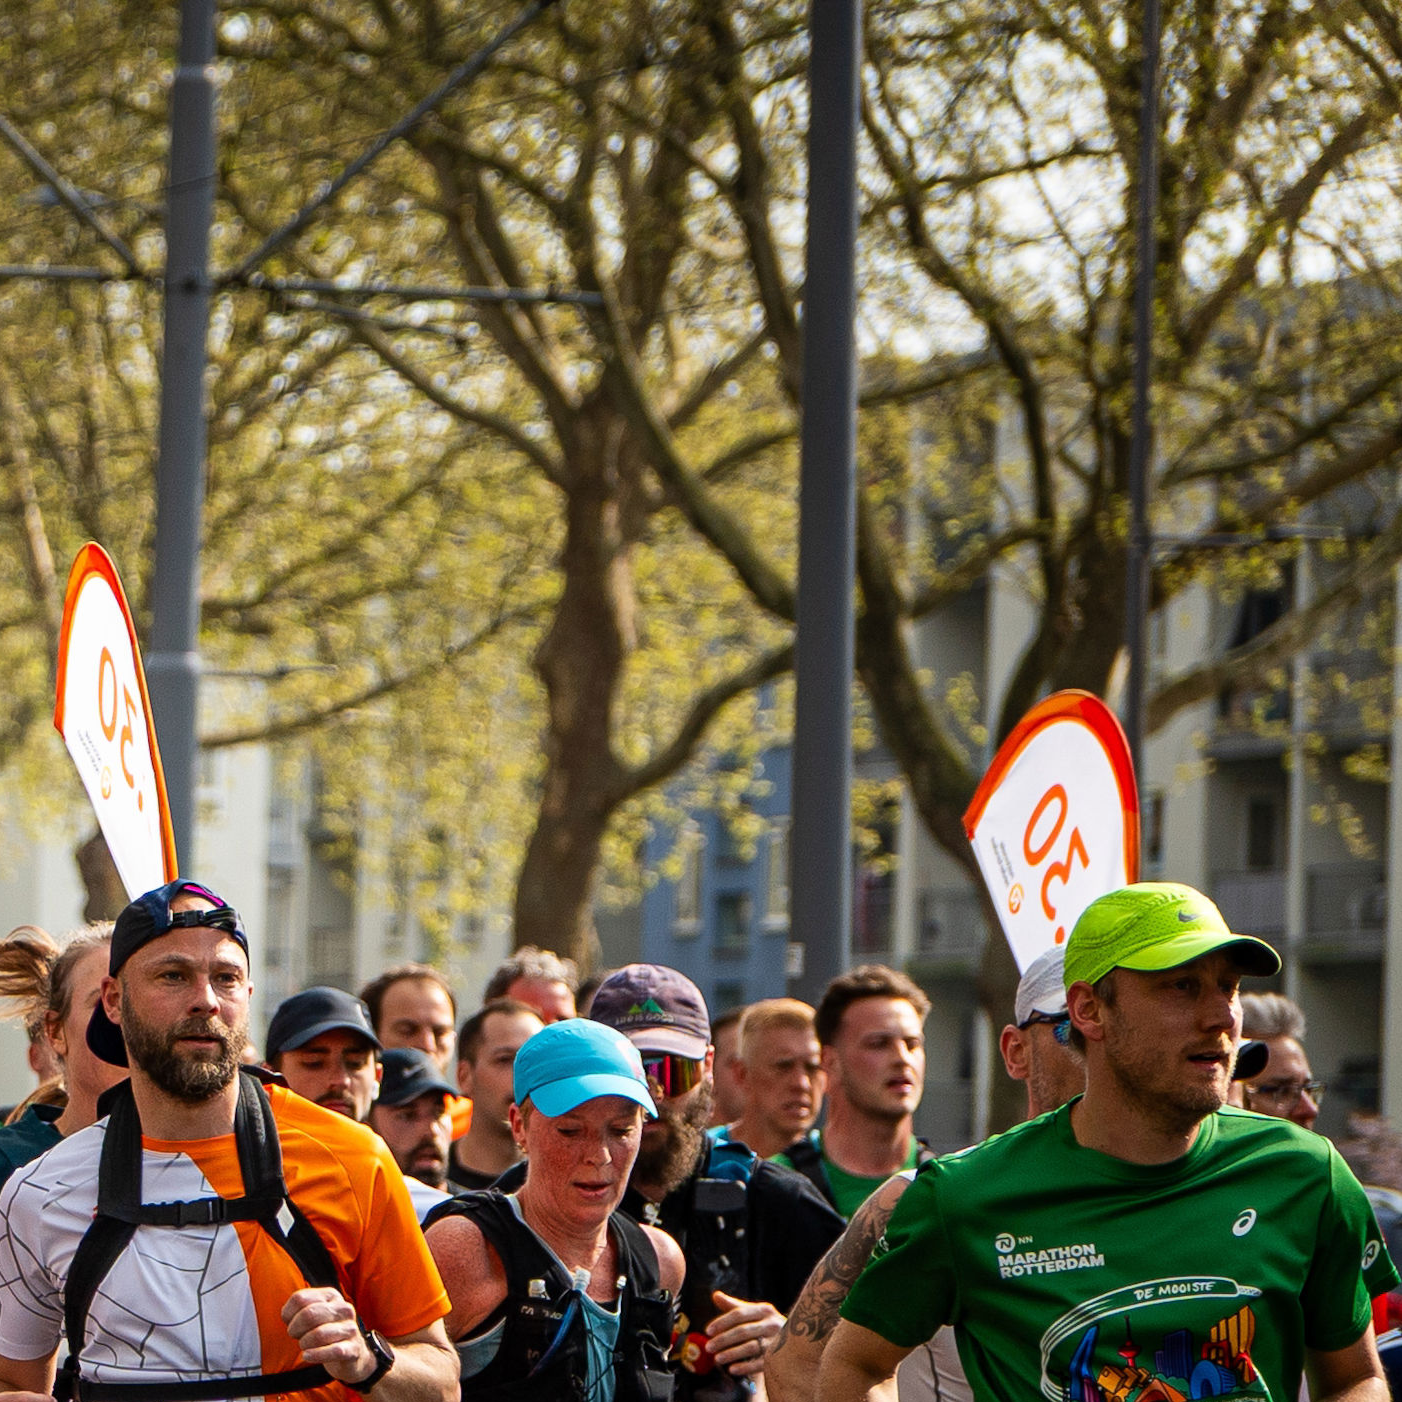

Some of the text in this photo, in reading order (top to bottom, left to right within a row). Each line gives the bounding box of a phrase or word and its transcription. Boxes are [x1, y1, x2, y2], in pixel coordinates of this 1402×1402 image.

[998, 1243, 1096, 1268] MARATHON
[999, 1254, 1105, 1279] ROTTERDAM
[1134, 1281, 1216, 1300] DE MOOISTE
